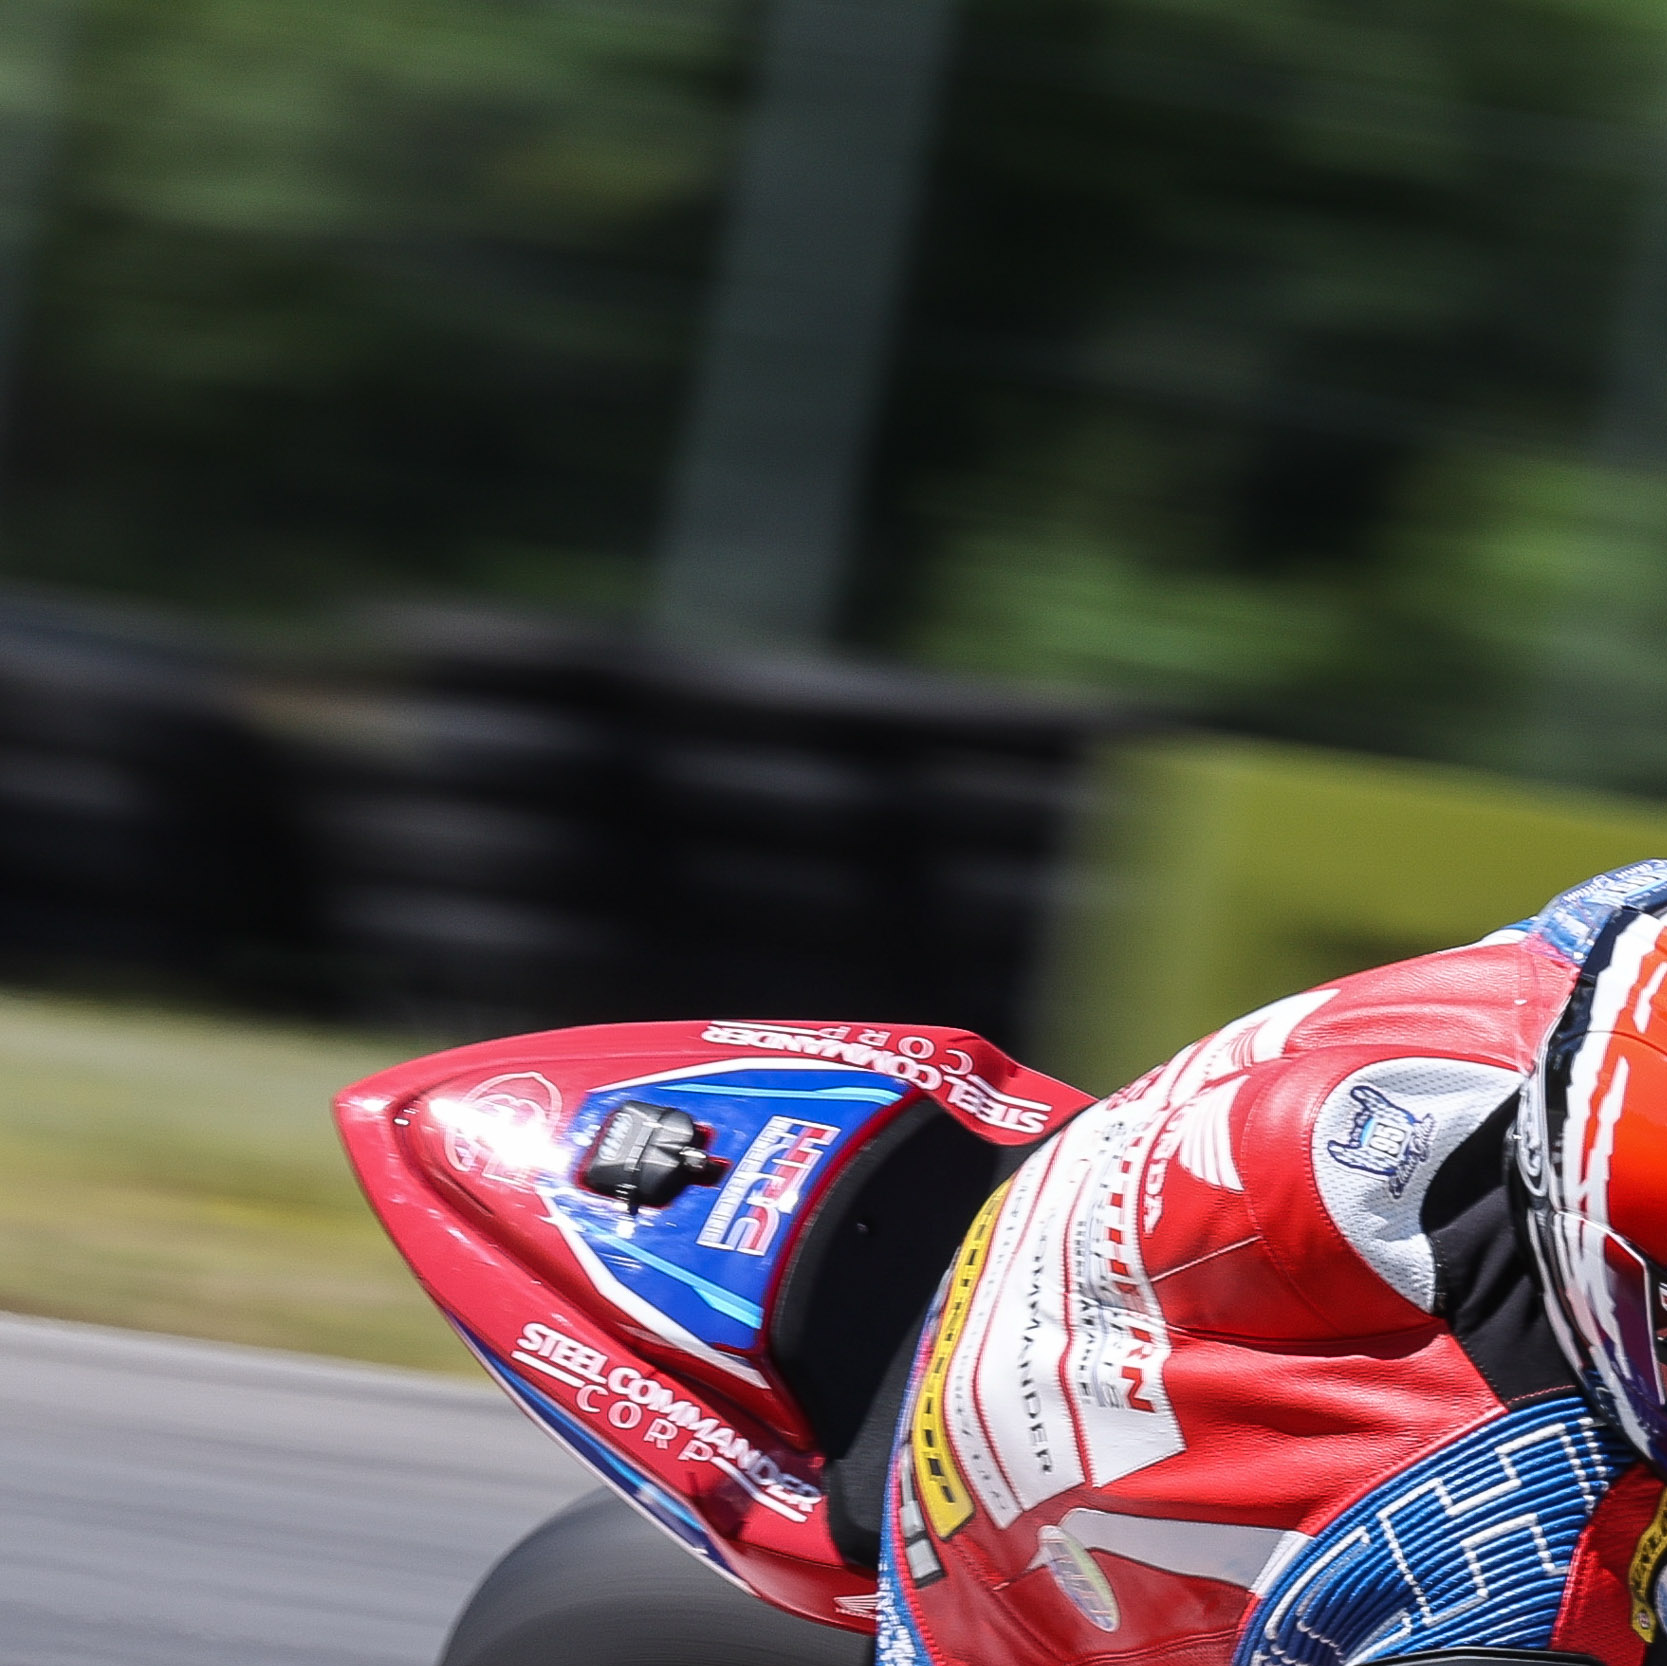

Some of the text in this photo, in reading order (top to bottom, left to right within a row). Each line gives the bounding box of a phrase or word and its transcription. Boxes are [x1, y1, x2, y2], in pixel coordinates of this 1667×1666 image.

[702, 1025, 1050, 1134] STEEL COMMANDER
[817, 1026, 974, 1076] CORP
[516, 1322, 823, 1513] STEEL COMMANDER
[576, 1384, 715, 1462] CORP
